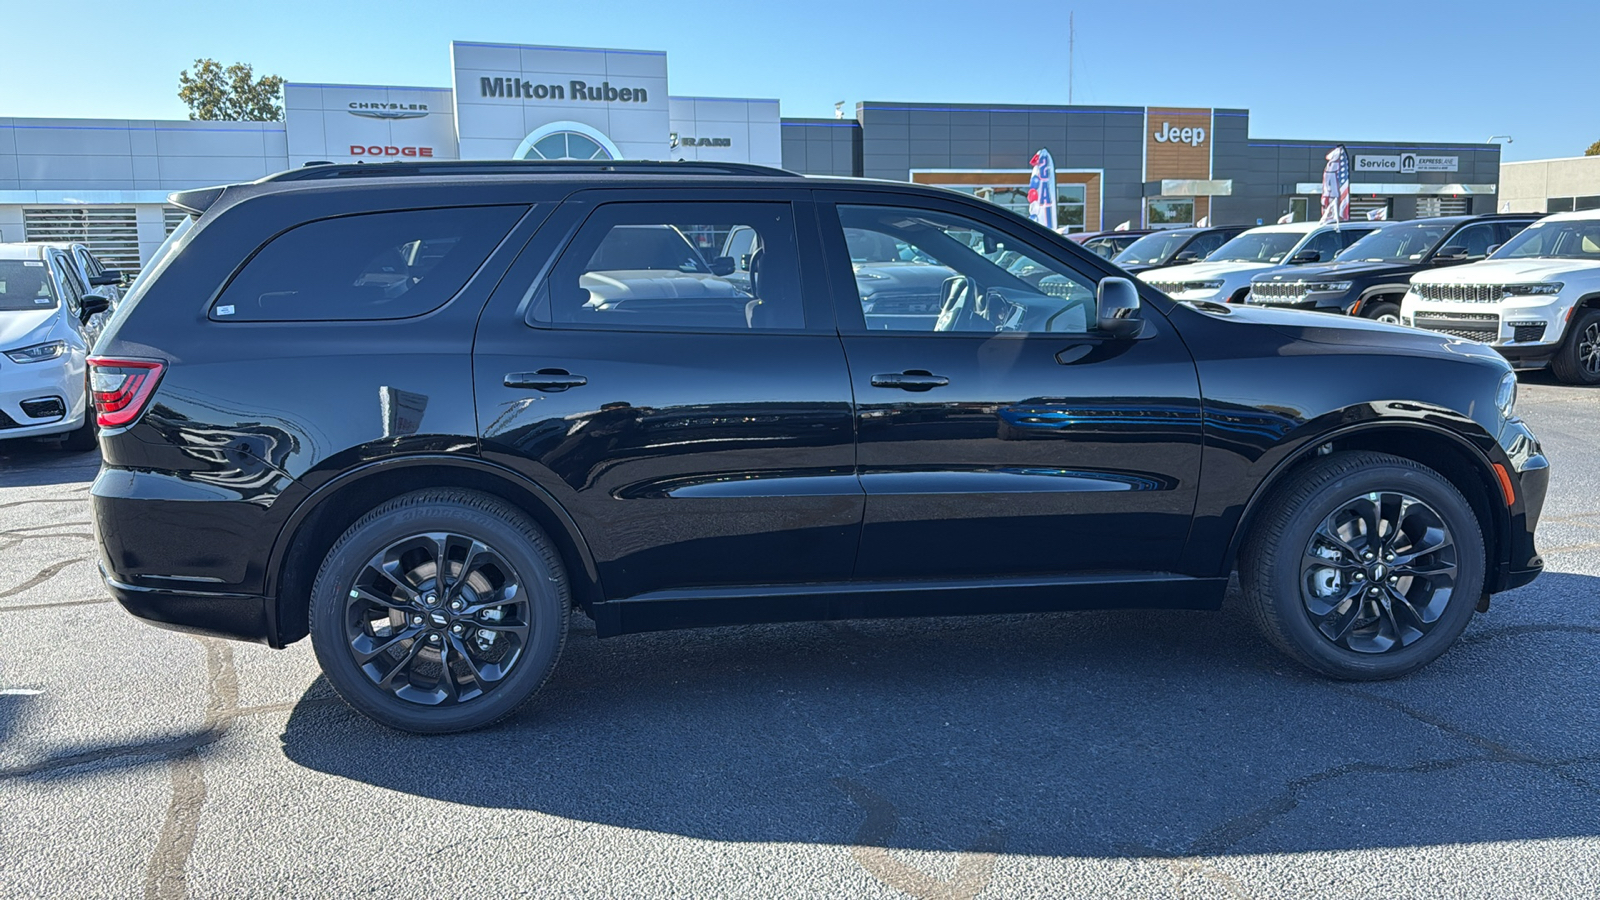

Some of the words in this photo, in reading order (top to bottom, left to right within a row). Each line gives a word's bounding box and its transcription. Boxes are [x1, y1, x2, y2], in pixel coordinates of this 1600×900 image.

[480, 77, 565, 100] Milton
[569, 80, 648, 103] Ruben
[348, 102, 429, 111] CHRYSLER
[1154, 121, 1205, 147] Jeep
[681, 137, 731, 147] RAM
[350, 145, 434, 157] DODGE
[1360, 158, 1396, 168] Service
